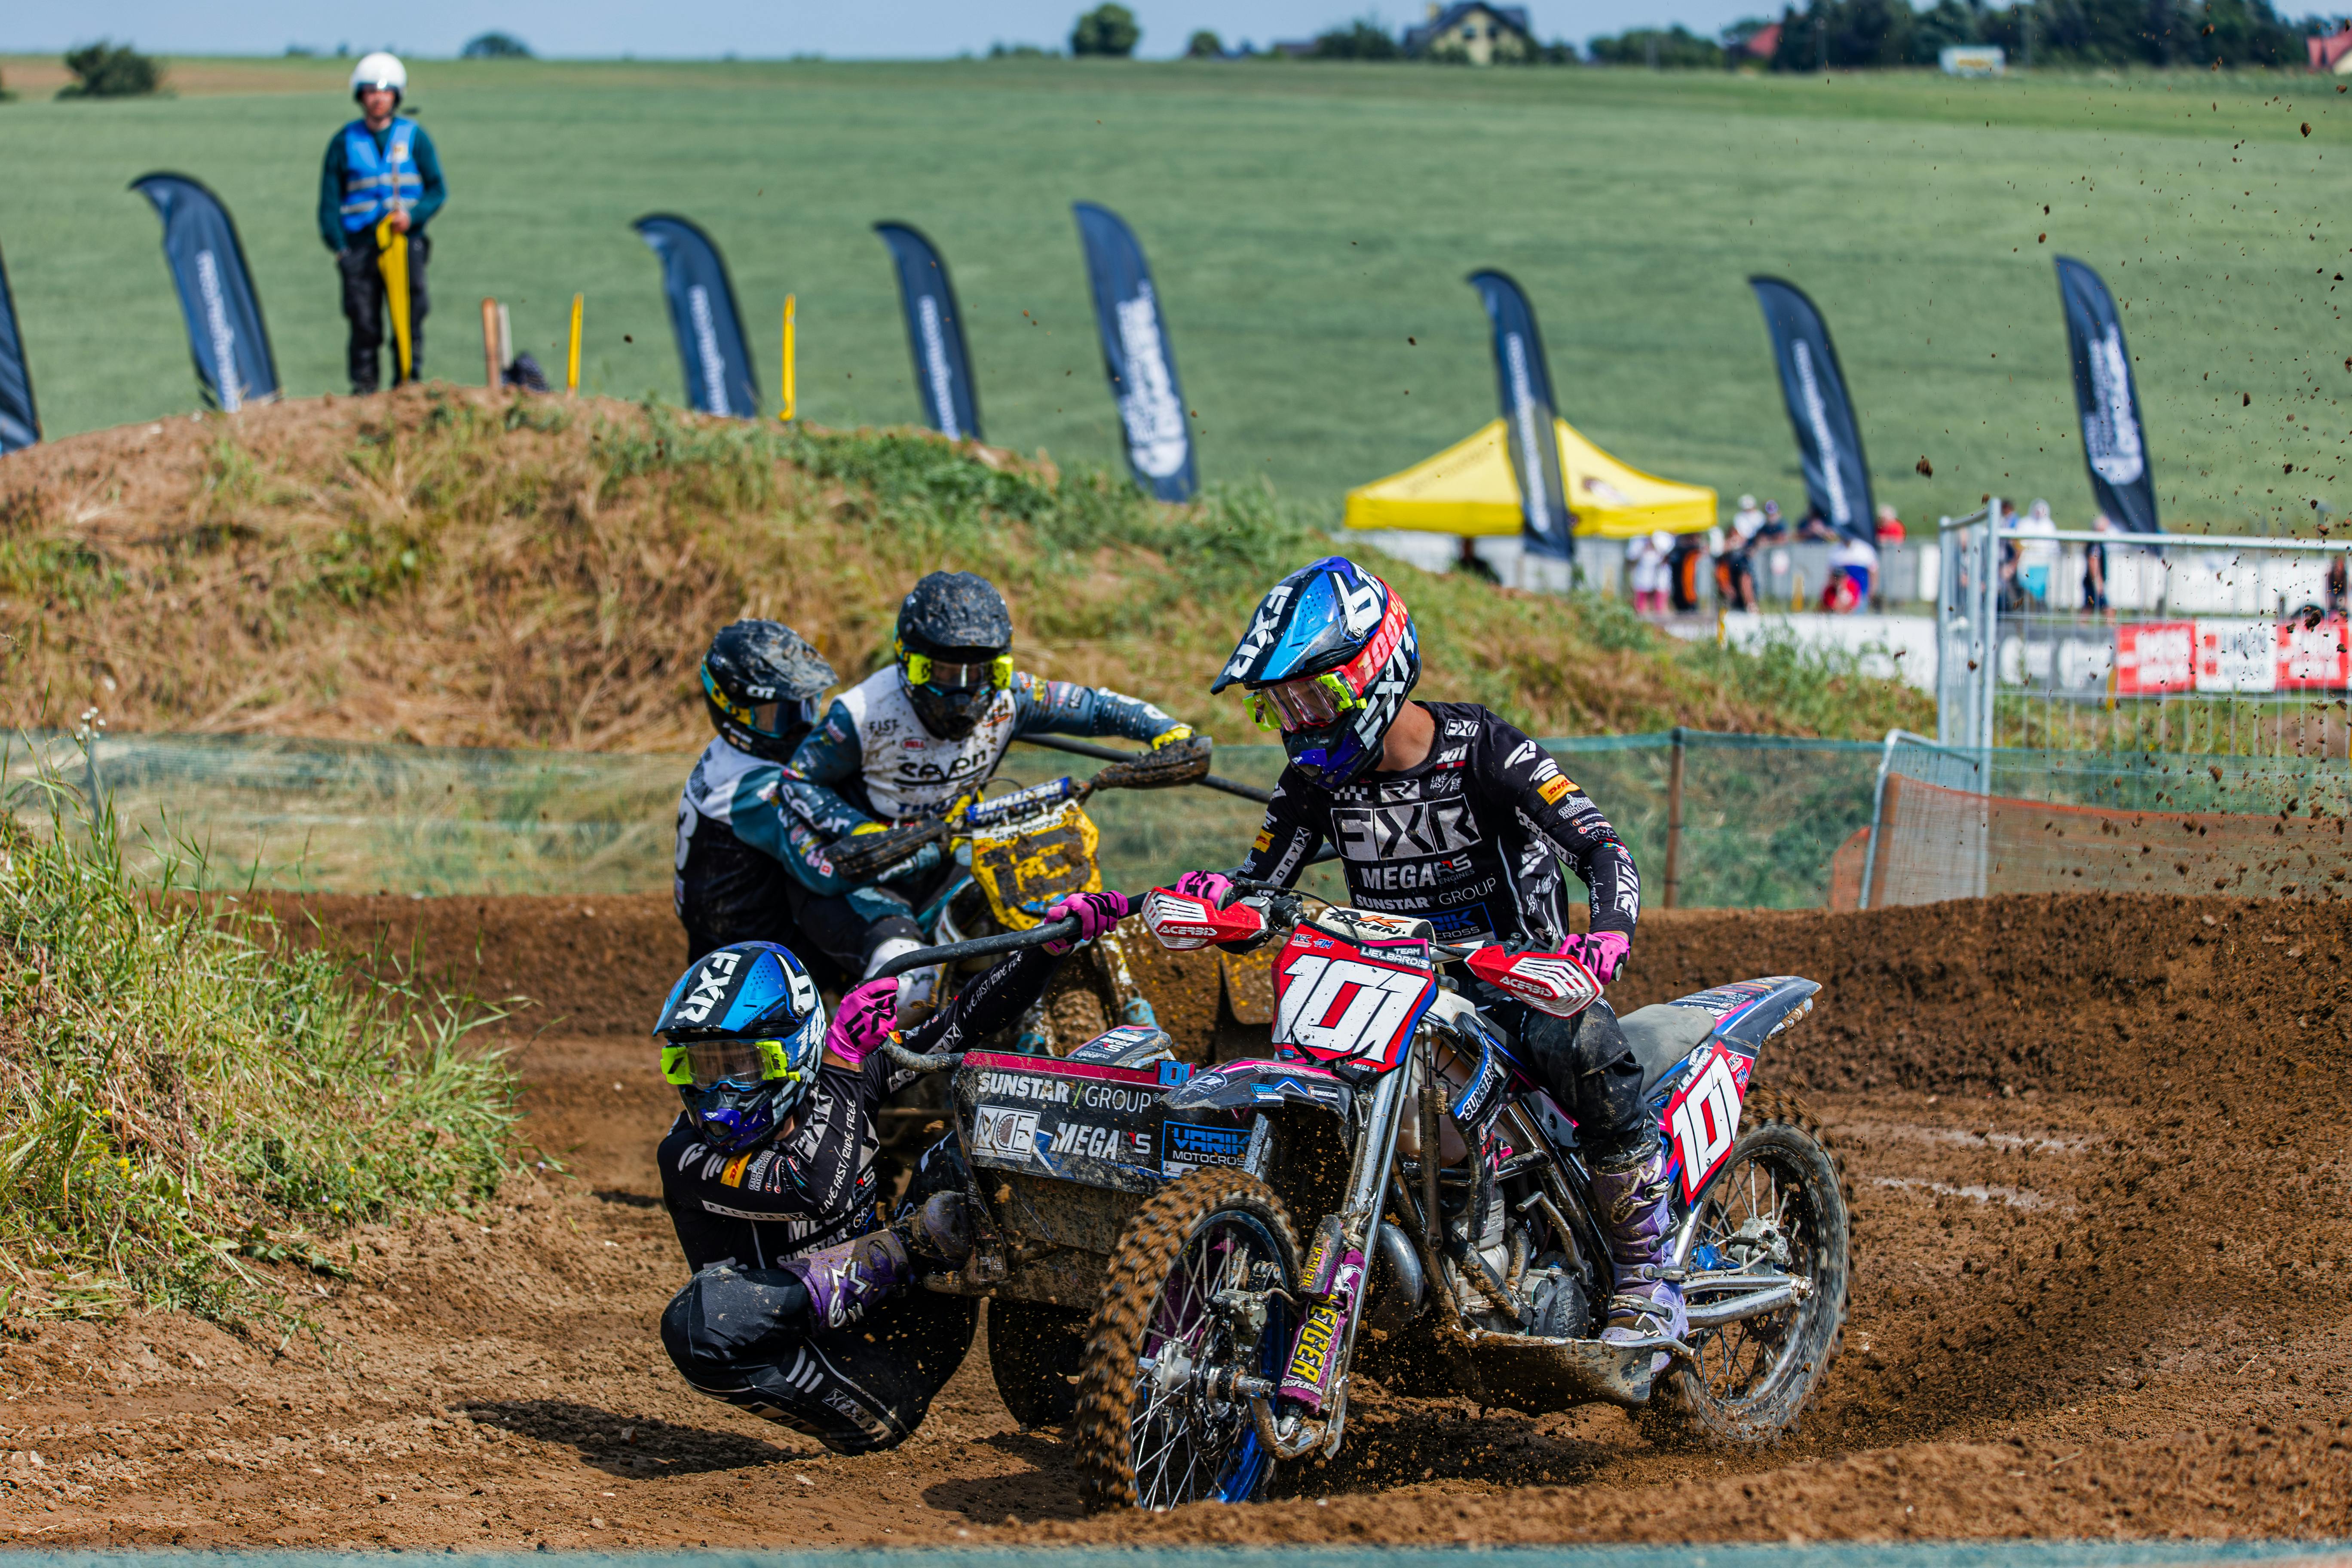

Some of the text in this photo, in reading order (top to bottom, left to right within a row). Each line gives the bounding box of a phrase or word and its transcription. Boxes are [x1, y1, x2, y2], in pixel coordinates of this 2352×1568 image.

[1224, 585, 1293, 679] FXR
[1357, 591, 1407, 681] 100%
[1436, 743, 1468, 764] 101
[1331, 793, 1482, 861] FXR
[1438, 868, 1475, 884] ENGINES
[1439, 877, 1496, 905] GROUP
[1394, 947, 1420, 956] TEAM
[675, 952, 741, 1023] FXR
[1272, 954, 1429, 1063] 101
[978, 1072, 1070, 1103] SUNSTAR
[1159, 1060, 1190, 1086] 101
[819, 1186, 838, 1214] LIVE
[846, 1099, 857, 1130] FREE
[1173, 1150, 1247, 1166] MOTOCROS
[708, 1204, 787, 1221] FACTORY
